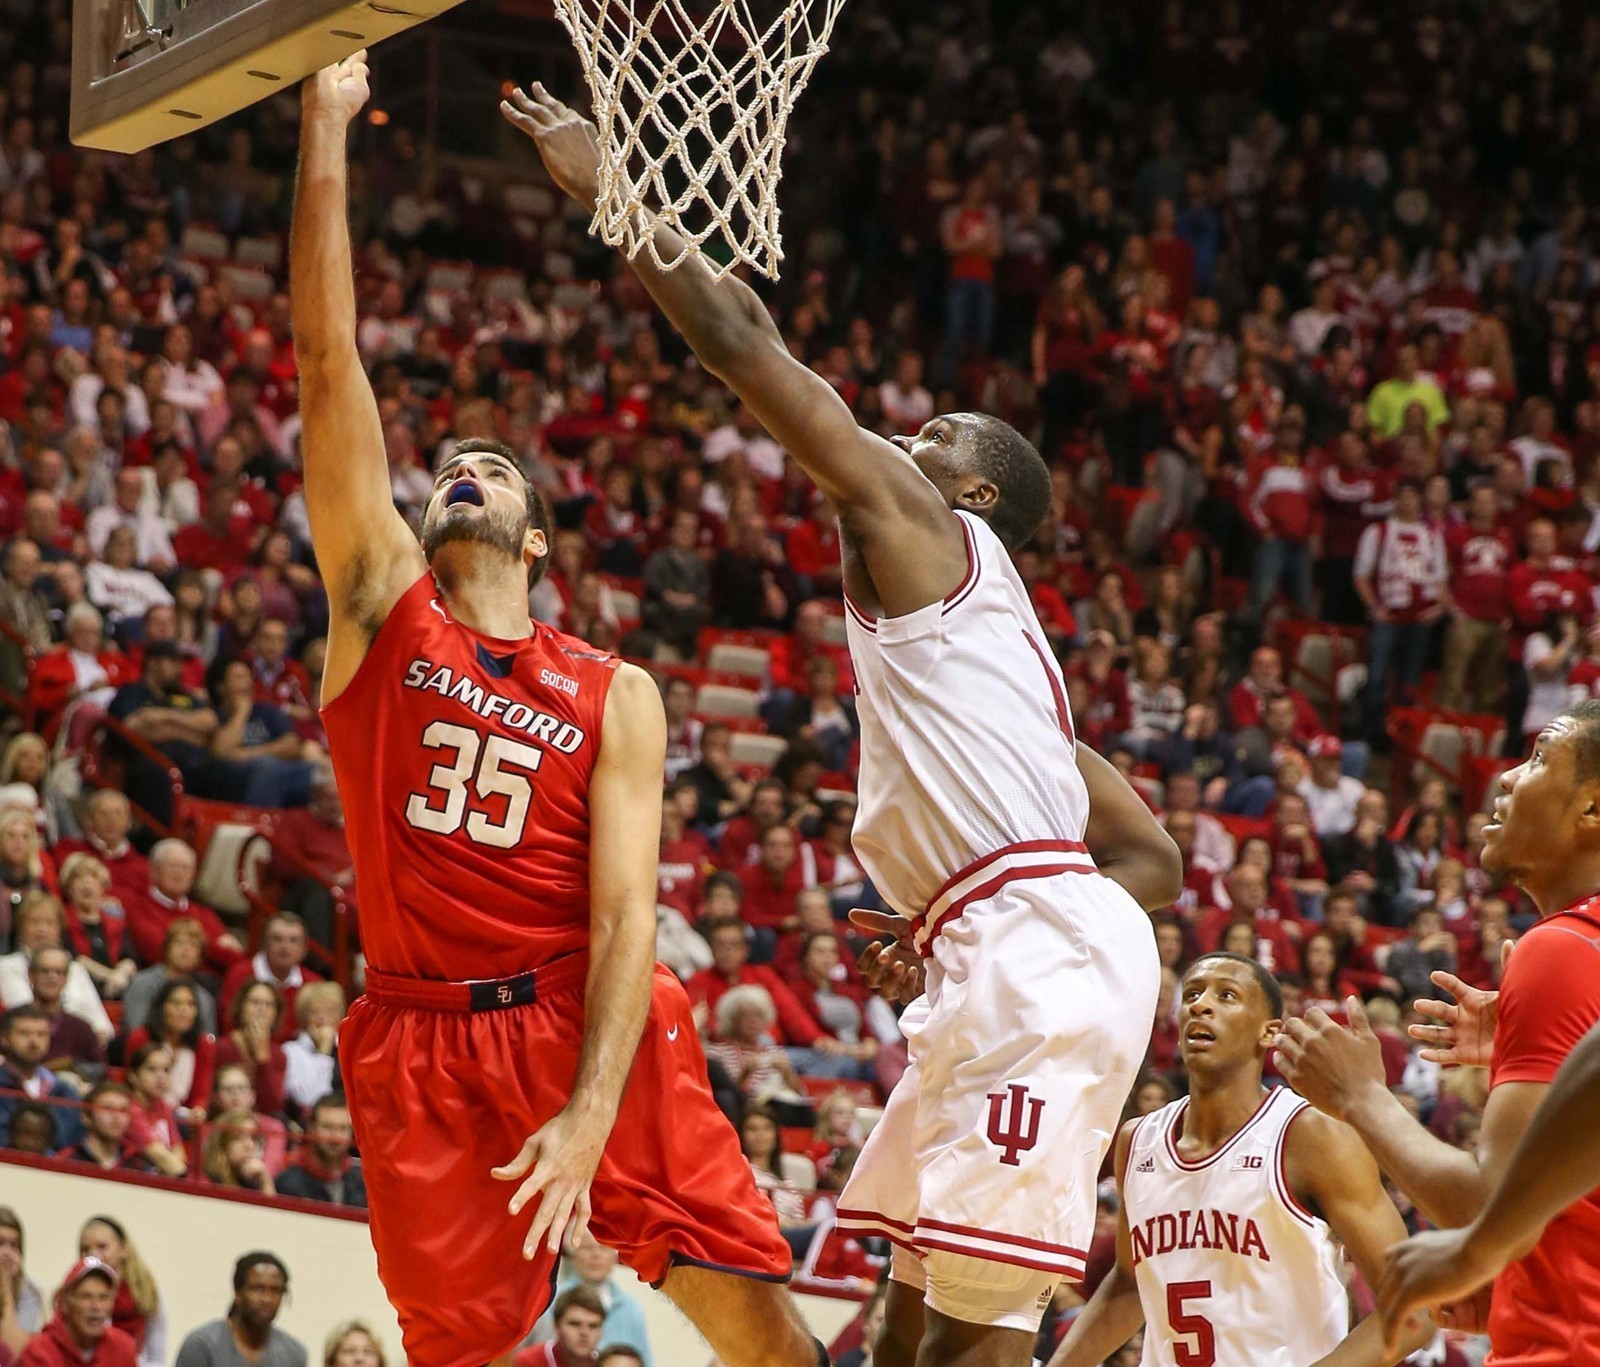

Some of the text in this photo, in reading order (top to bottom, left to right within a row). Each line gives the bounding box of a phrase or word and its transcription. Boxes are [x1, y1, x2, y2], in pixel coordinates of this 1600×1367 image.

[403, 659, 585, 755] SAMFORD
[540, 668, 579, 698] SOCON
[405, 720, 543, 850] 35
[497, 985, 513, 1004] SU
[1130, 1208, 1271, 1267] NDIANA
[1167, 1280, 1215, 1367] 5
